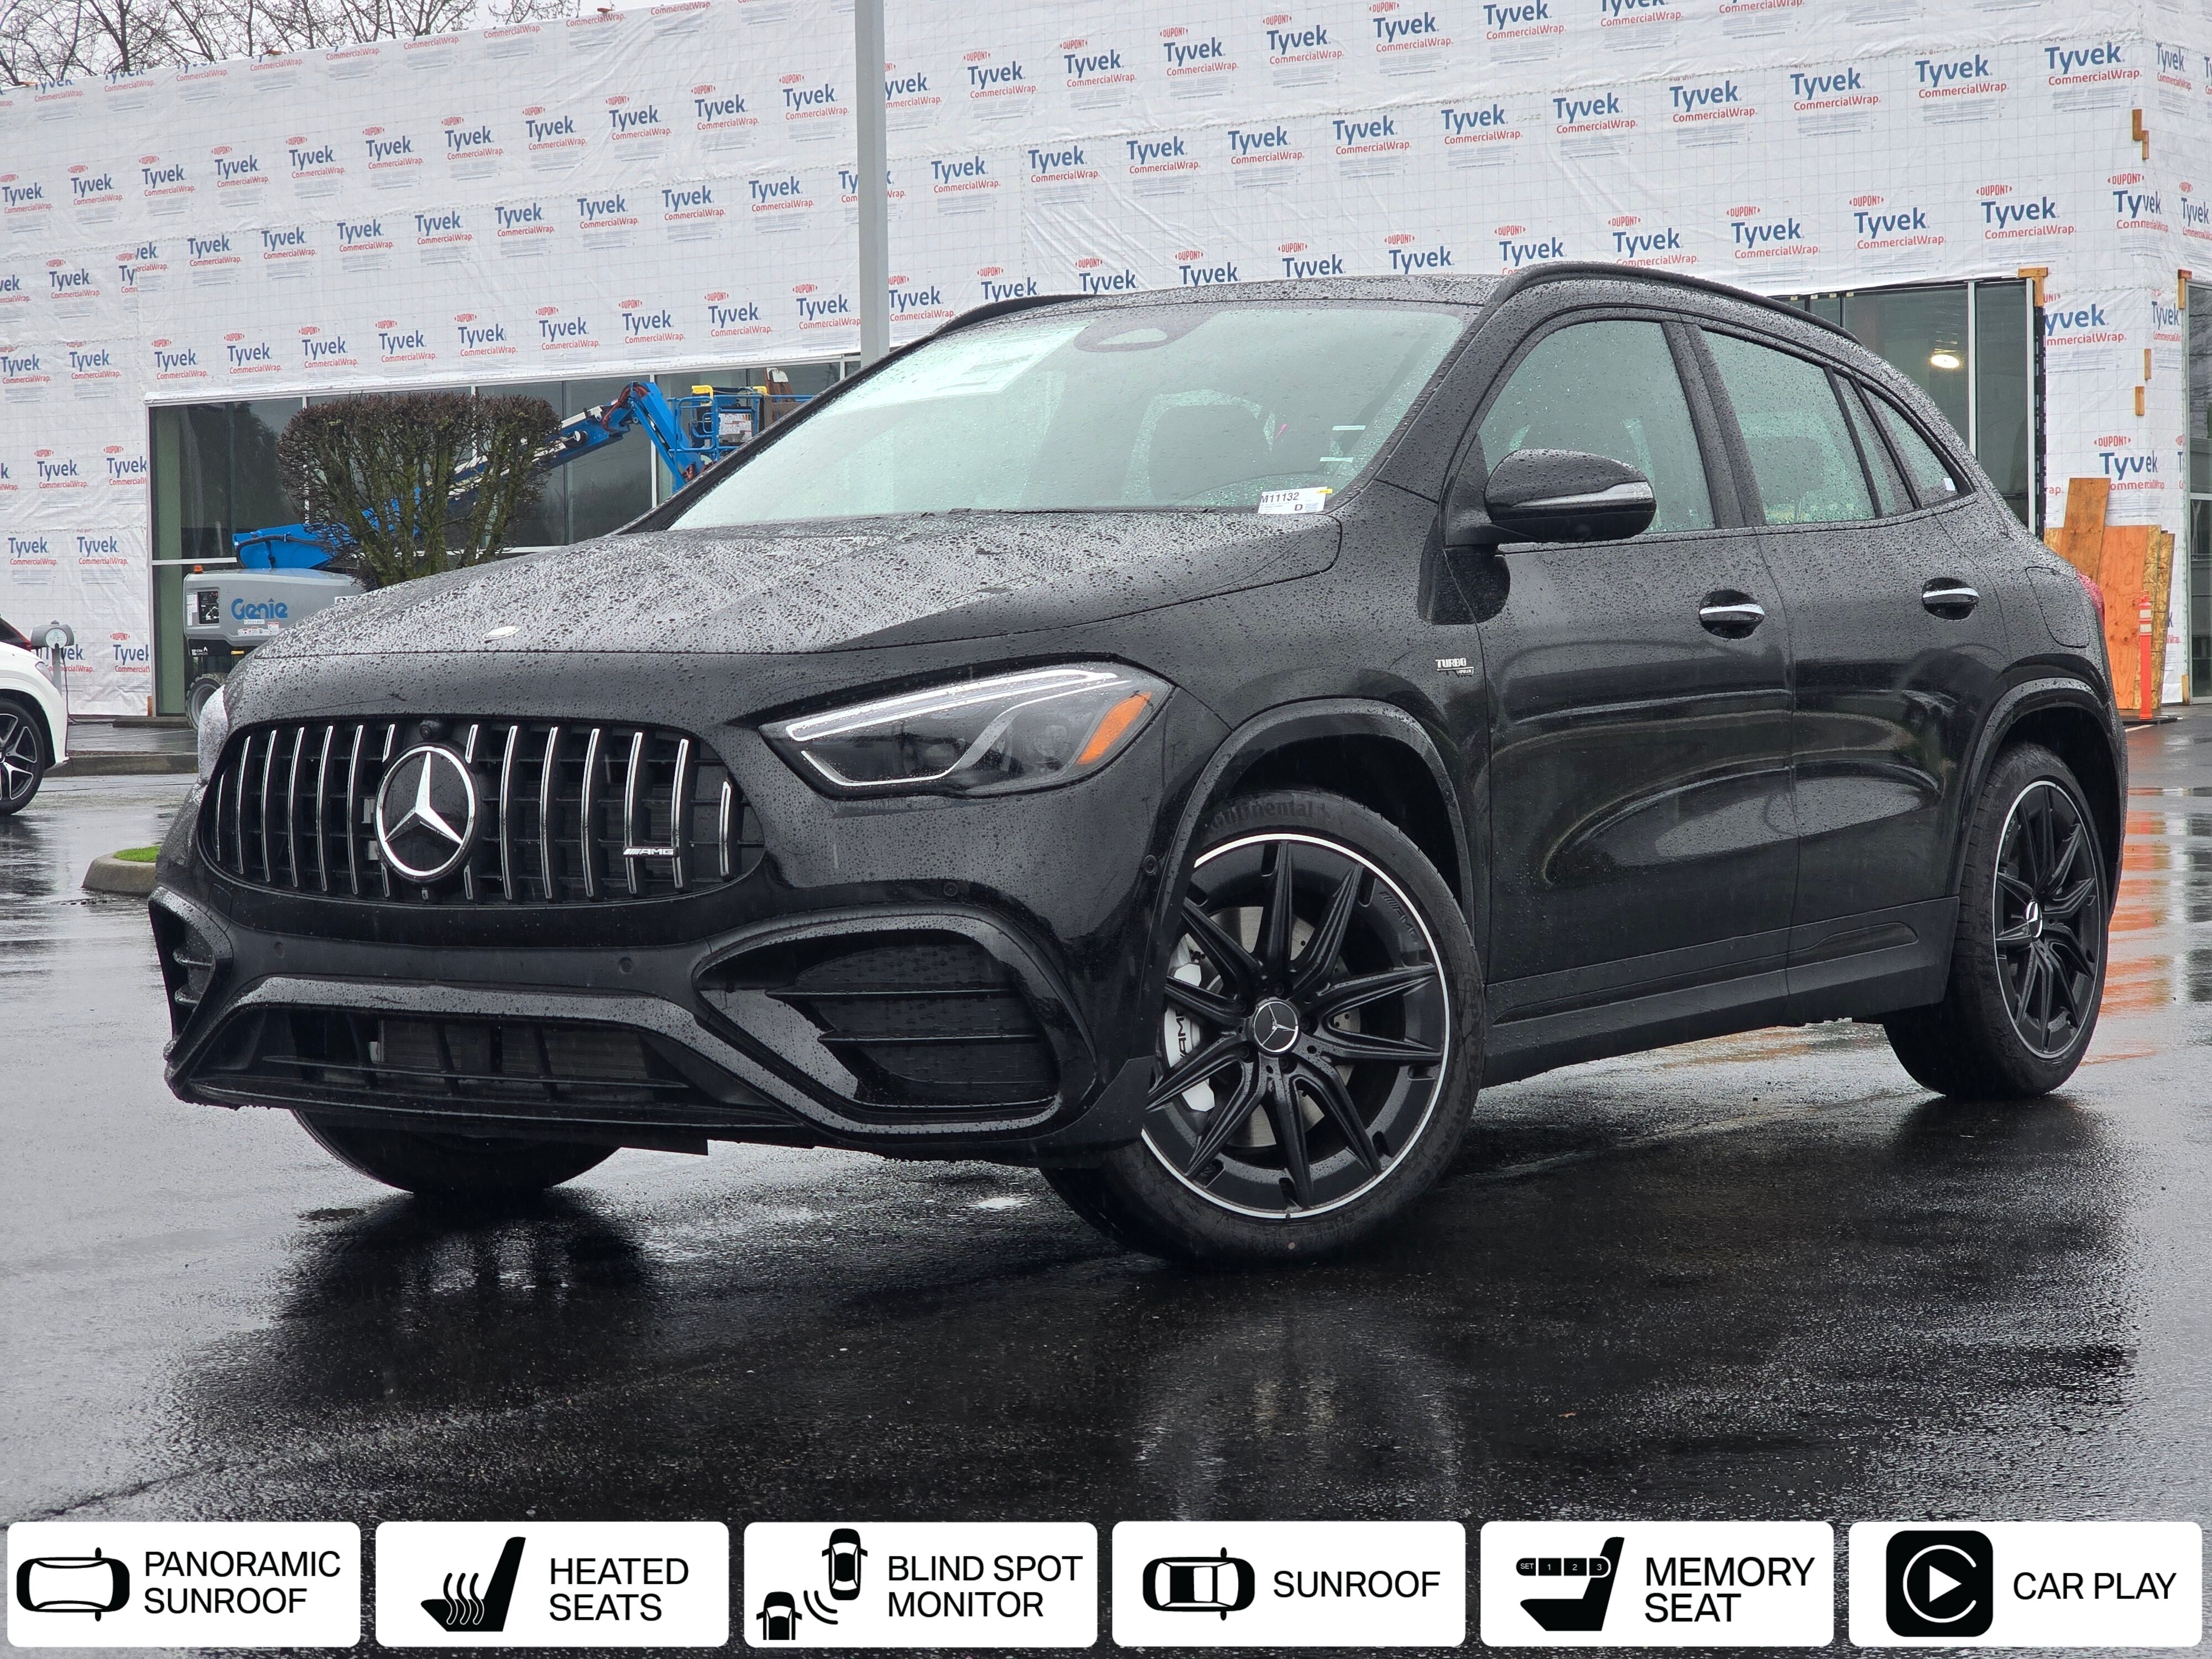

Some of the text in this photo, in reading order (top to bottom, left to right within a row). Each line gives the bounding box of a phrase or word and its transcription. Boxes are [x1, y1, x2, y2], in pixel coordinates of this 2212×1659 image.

[1373, 12, 1435, 43] Tyvek
[1483, 0, 1548, 30] Tyvek
[1165, 37, 1222, 66] Tyvek
[1266, 25, 1327, 54] Tyvek
[1065, 49, 1121, 78] Tyvek
[1915, 54, 1989, 88] Tyvek
[2044, 41, 2122, 74] Tyvek
[2156, 42, 2185, 72] Tyvek
[885, 72, 928, 101] yvek
[968, 61, 1024, 89] Tyvek
[1790, 67, 1862, 100] Tyvek
[695, 97, 745, 121] Tyvek
[784, 84, 834, 111] Tyvek
[886, 96, 941, 108] mmercialWrap
[1553, 92, 1619, 124] Tyvek
[1670, 80, 1739, 112] Tyvek
[609, 106, 658, 129] Tyvek
[1332, 114, 1395, 145] Tyvek
[1441, 103, 1505, 134] Tyvek
[366, 137, 410, 160] Tyvek
[1126, 136, 1185, 164] Tyvek
[1227, 126, 1287, 155] Tyvek
[931, 156, 985, 184] Tyvek
[1027, 145, 1084, 173] Tyvek
[142, 166, 184, 186] Tyvek
[749, 176, 800, 204] Tyvek
[577, 195, 625, 220] Tyvek
[662, 185, 712, 211] Tyvek
[2112, 190, 2162, 218] Tyvek
[2181, 197, 2210, 227] Tyvek
[495, 203, 541, 227] Tyvek
[1854, 207, 1927, 239] Tyvek
[1982, 196, 2057, 229] Tyvek
[262, 228, 305, 251] Tyvek
[1613, 227, 1680, 258] Tyvek
[1731, 217, 1802, 249] Tyvek
[1388, 246, 1452, 275] Tyvek
[1499, 237, 1564, 266] Tyvek
[1178, 262, 1239, 286] Tyvek
[1282, 254, 1343, 279] Tyvek
[981, 277, 1036, 301] Tyvek
[1079, 270, 1135, 296] Tyvek
[797, 294, 848, 320] Tyvek
[889, 286, 941, 311] Tyvek
[539, 317, 587, 341] Tyvek
[622, 309, 672, 334] Tyvek
[708, 302, 761, 328] Tyvek
[2045, 304, 2106, 336] yvek
[2152, 301, 2179, 330] Tyvek
[302, 336, 346, 359] Tyvek
[2047, 332, 2125, 346] mmercialWrap
[154, 348, 196, 372] Tyvek
[36, 460, 77, 481] Tyvek
[2099, 450, 2158, 481] Tyvek
[8, 537, 47, 558] Tyvek
[231, 598, 288, 620] Genie
[1435, 658, 1467, 668] TURBO
